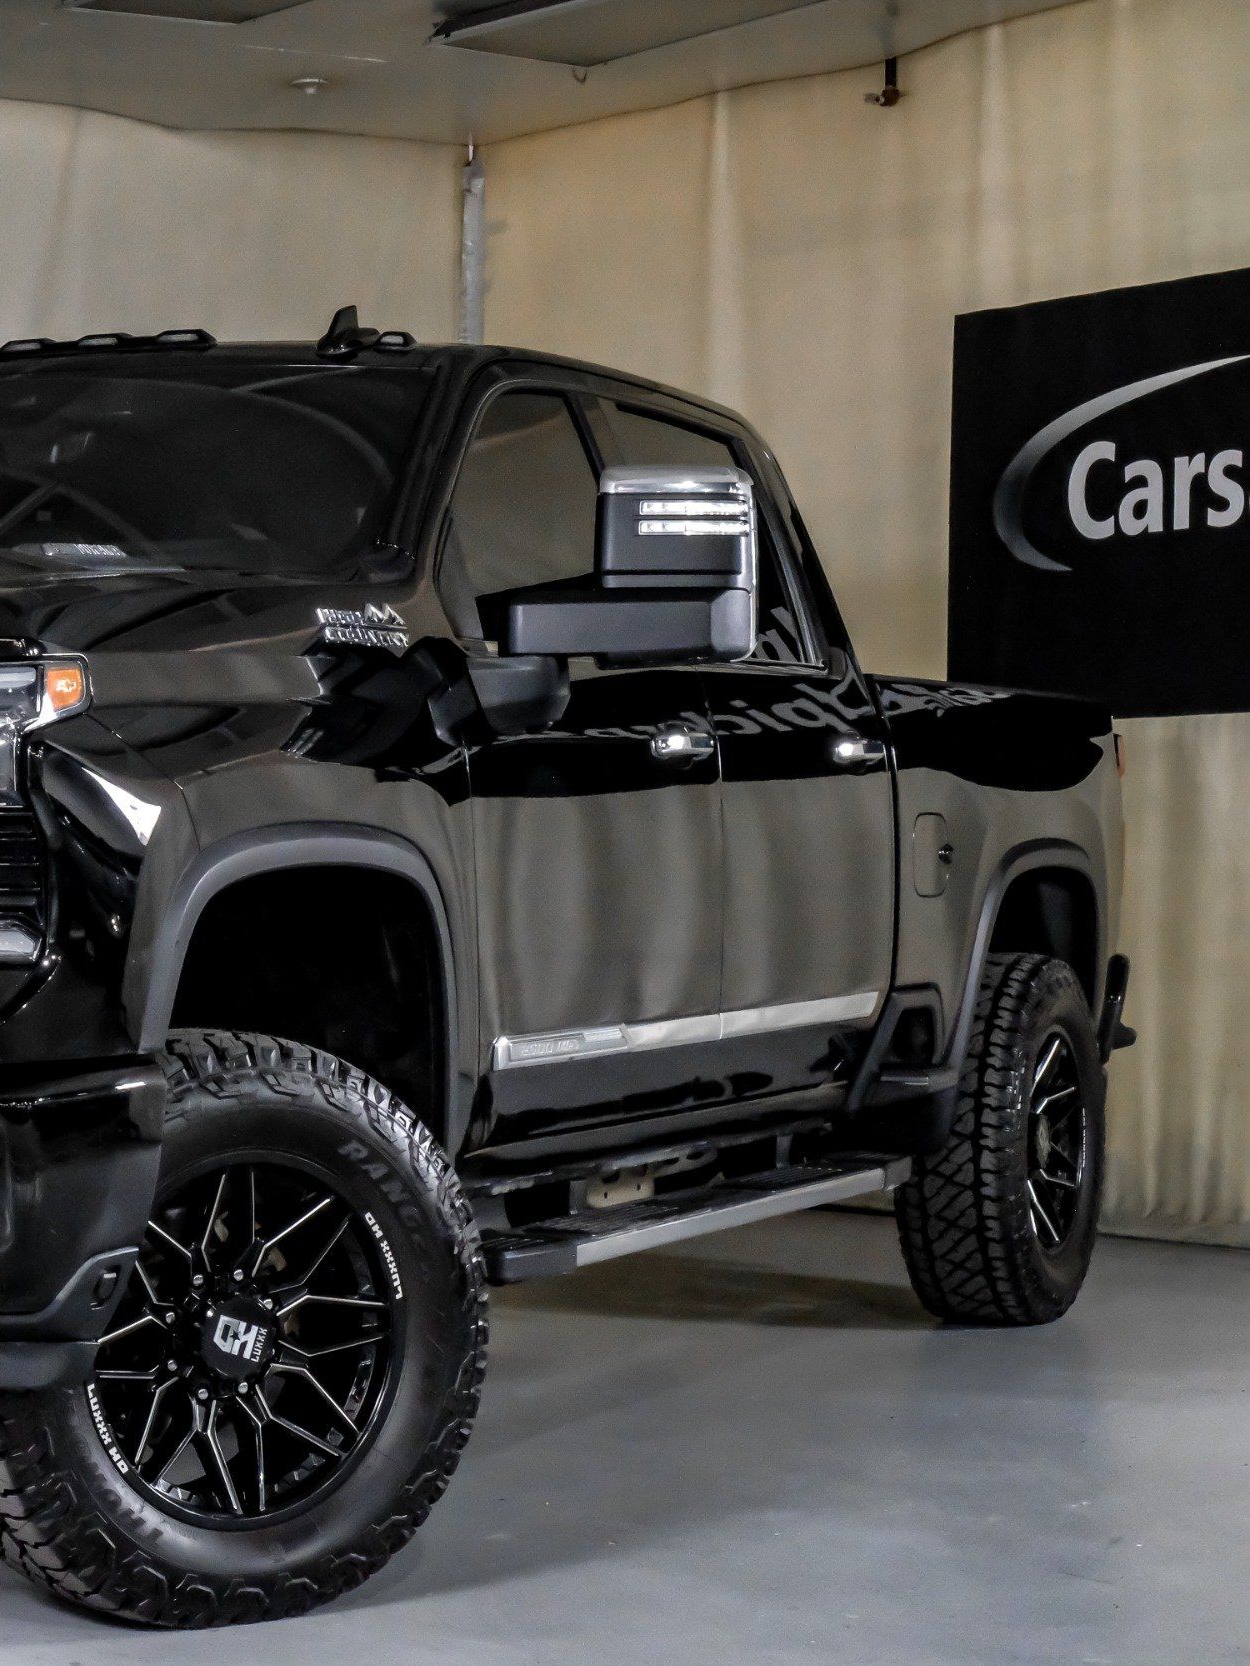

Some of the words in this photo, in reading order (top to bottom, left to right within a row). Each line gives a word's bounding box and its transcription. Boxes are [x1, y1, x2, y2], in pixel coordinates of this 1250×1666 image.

[1068, 440, 1250, 540] Cars
[364, 1211, 384, 1239] HD
[380, 1240, 403, 1300] LUXXX
[250, 1327, 268, 1363] LUXXX
[87, 1383, 112, 1445] LUXXX
[108, 1446, 129, 1474] HD
